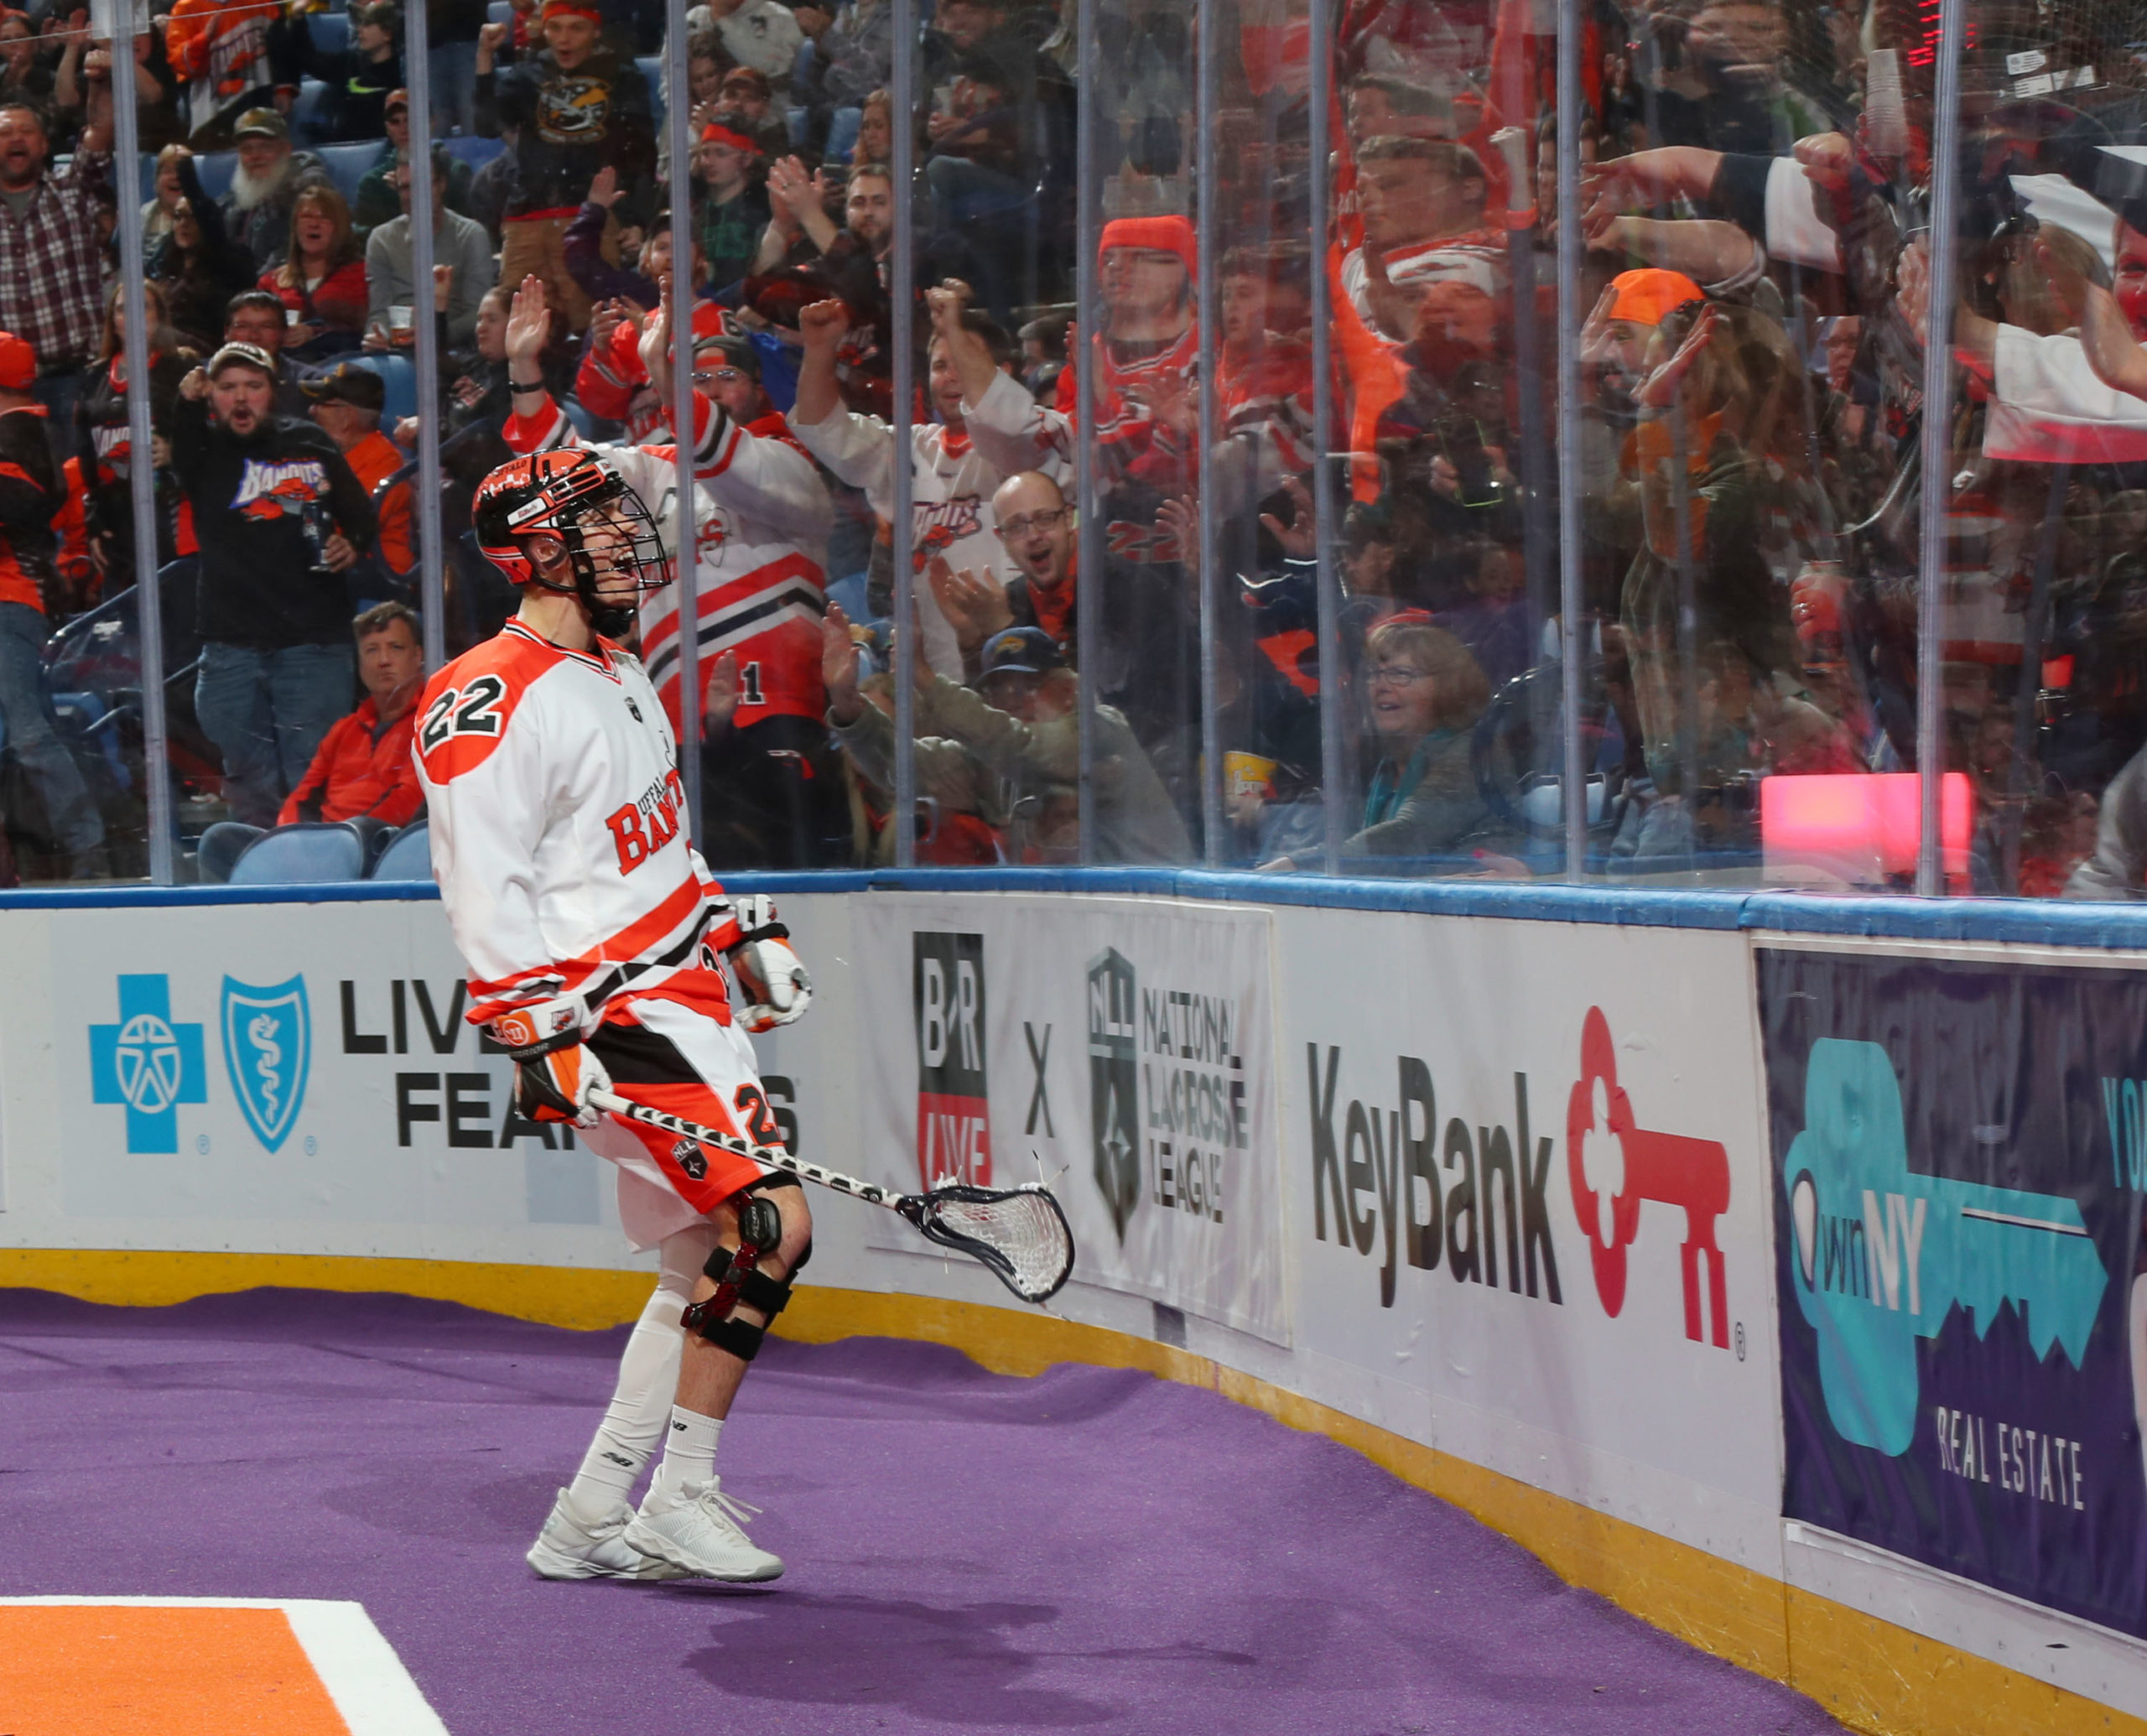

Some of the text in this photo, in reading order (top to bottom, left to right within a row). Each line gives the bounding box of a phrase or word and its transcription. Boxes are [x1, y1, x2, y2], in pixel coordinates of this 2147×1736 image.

[230, 459, 325, 508] BANDITS
[422, 673, 507, 757] 22
[738, 661, 767, 705] 1
[1142, 986, 1243, 1070] NATIONAL
[1023, 1021, 1055, 1139] X
[1144, 1062, 1249, 1151] LACROSSE
[673, 1141, 697, 1161] NLL
[926, 1112, 987, 1187] LIVE
[1150, 1138, 1224, 1224] LEAGUE
[1307, 1042, 1563, 1308] KeyBank
[1937, 1406, 2084, 1510] REAL ESTATE
